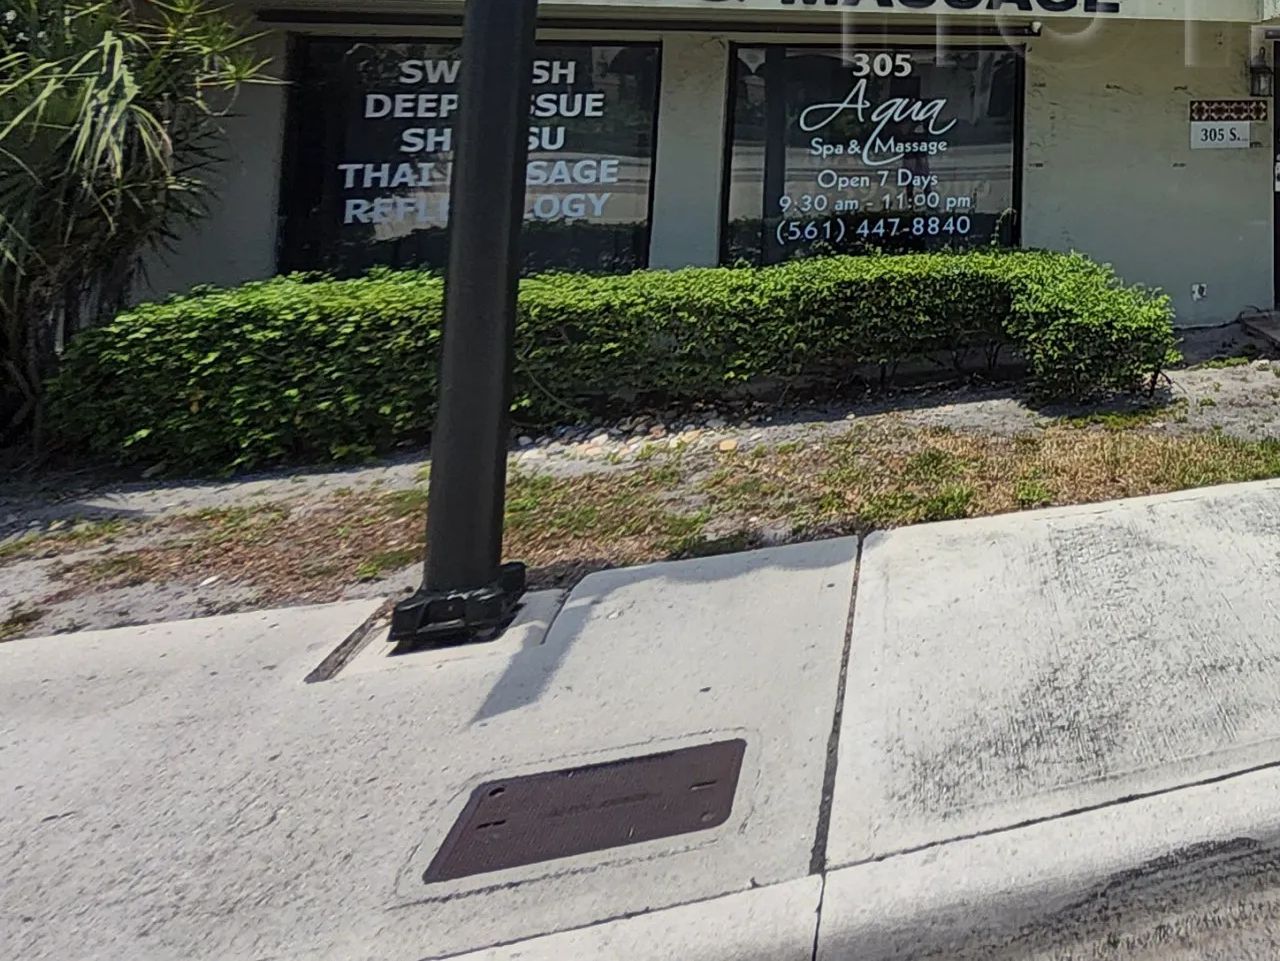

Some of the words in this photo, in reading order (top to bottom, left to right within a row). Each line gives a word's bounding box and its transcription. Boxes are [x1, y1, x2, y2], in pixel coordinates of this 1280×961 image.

[400, 59, 576, 84] SWSH
[852, 53, 913, 77] 305
[364, 94, 458, 119] DEEP
[800, 78, 957, 166] Aqua
[1200, 128, 1225, 142] 305
[1229, 127, 1241, 142] S.
[400, 126, 565, 152] SHSU
[810, 137, 844, 159] Spa
[847, 139, 862, 154] &
[874, 136, 947, 156] Massage
[337, 163, 436, 189] THAI
[817, 169, 870, 190] Open
[877, 171, 889, 187] 7
[897, 169, 938, 189] Days
[779, 194, 828, 212] 9:30
[834, 198, 859, 211] am
[882, 192, 940, 210] 11:00
[946, 196, 971, 211] pm
[776, 217, 846, 245] (561)
[856, 216, 971, 238] 447-8840
